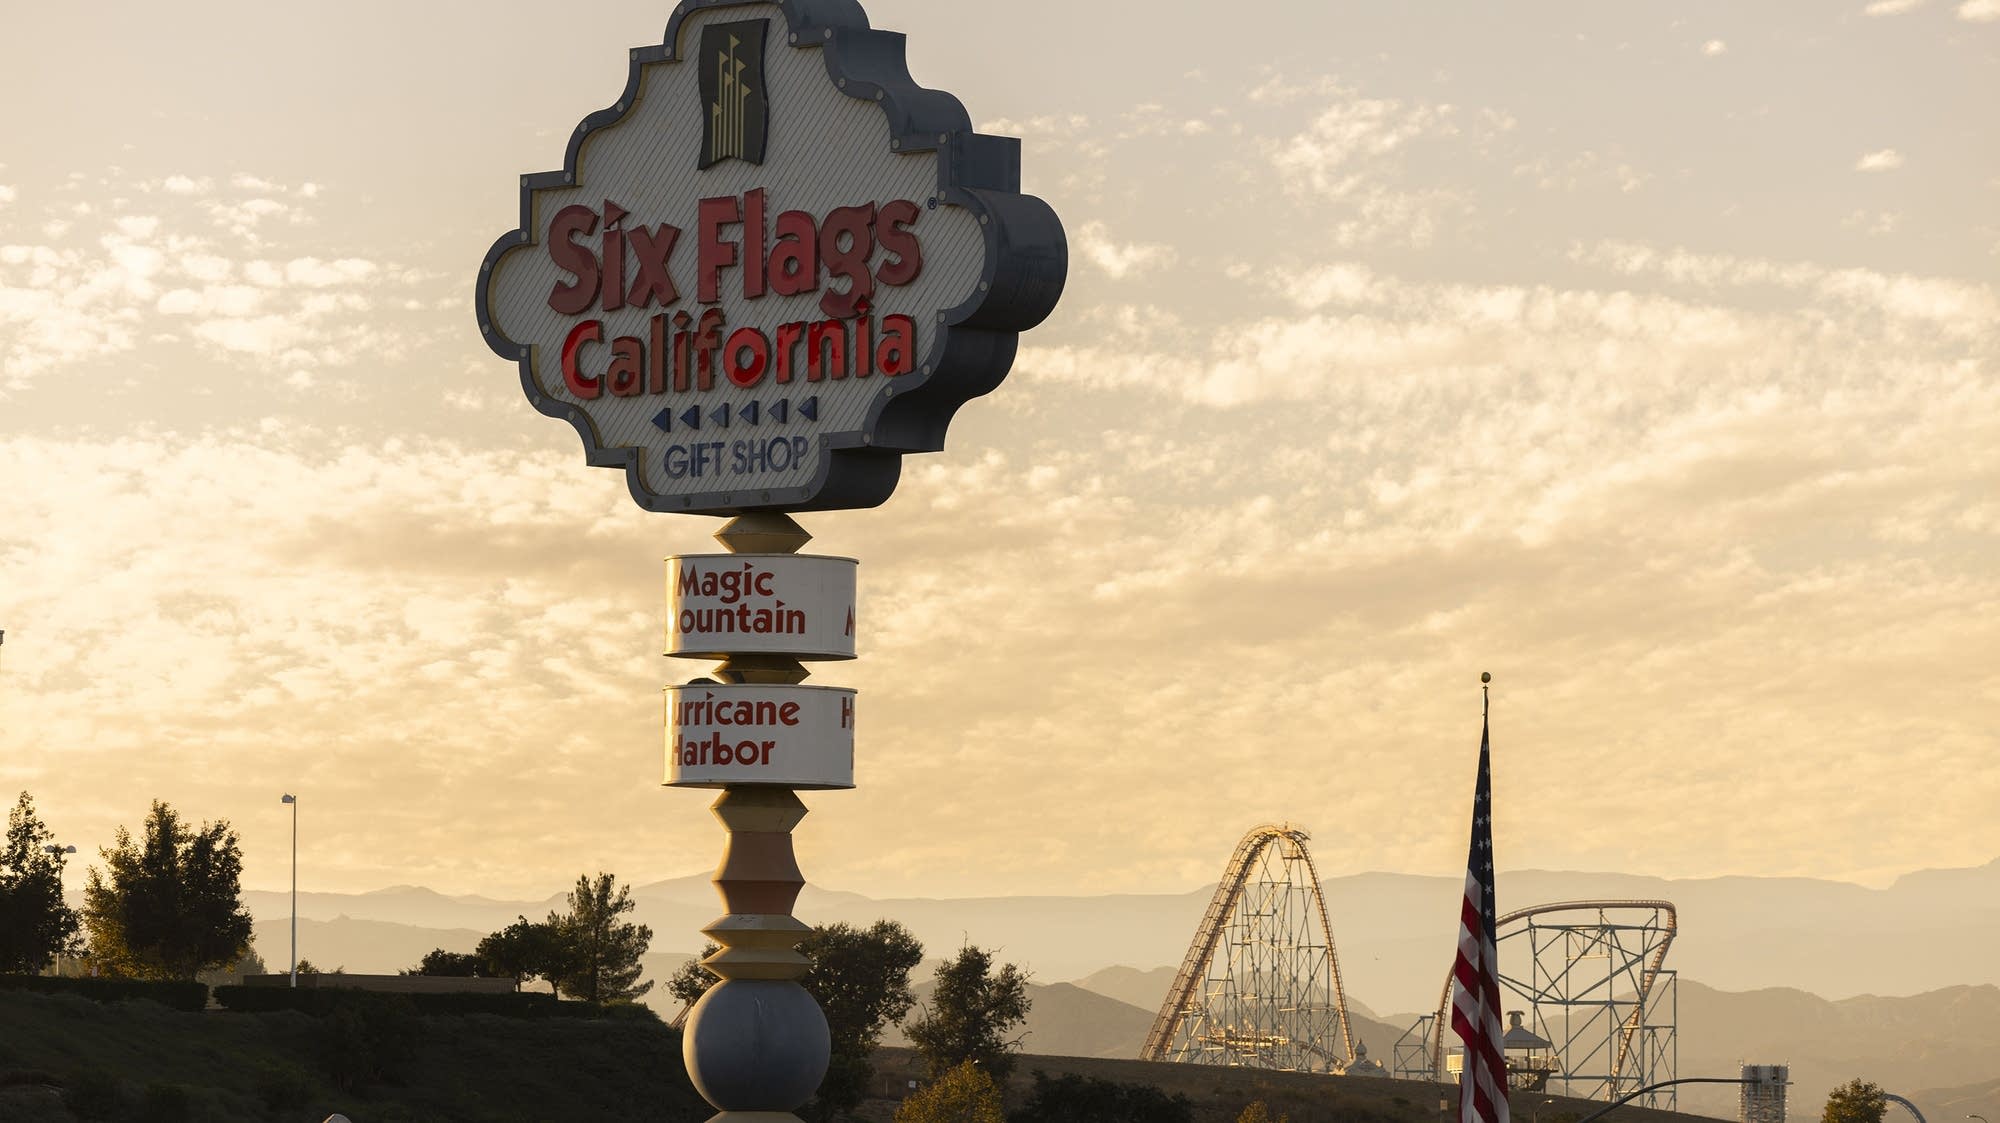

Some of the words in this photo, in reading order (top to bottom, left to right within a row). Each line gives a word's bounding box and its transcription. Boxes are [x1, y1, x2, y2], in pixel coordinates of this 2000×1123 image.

[547, 199, 681, 315] Six
[698, 187, 924, 319] Flags
[561, 295, 916, 399] California
[664, 441, 725, 480] GIFT
[731, 436, 809, 475] SHOP
[677, 562, 775, 604] Magic
[676, 600, 806, 634] ountain
[672, 692, 801, 726] urricane
